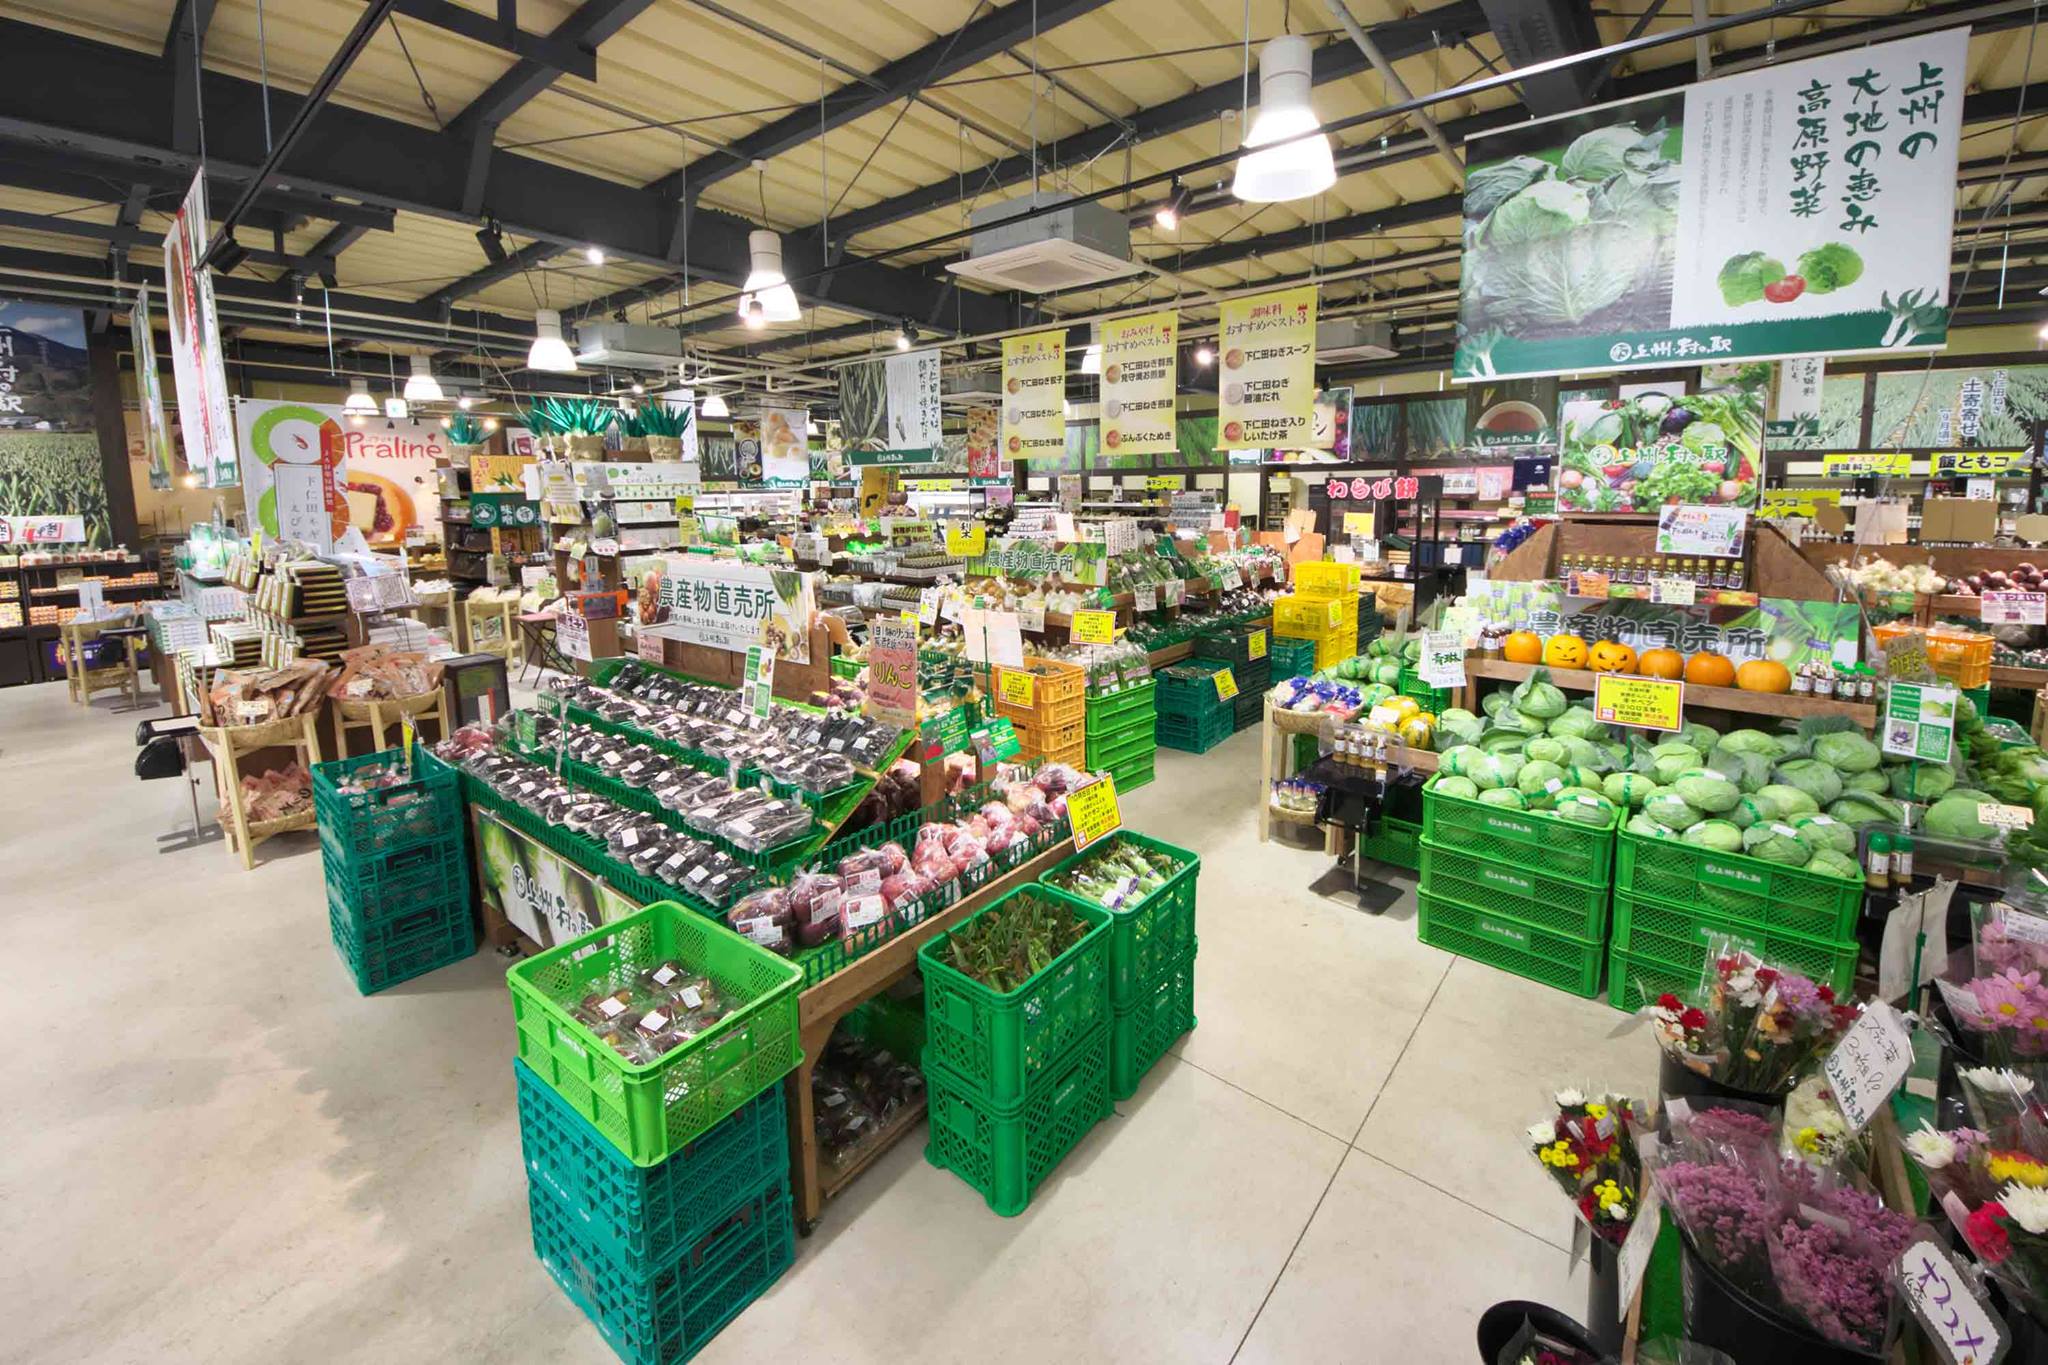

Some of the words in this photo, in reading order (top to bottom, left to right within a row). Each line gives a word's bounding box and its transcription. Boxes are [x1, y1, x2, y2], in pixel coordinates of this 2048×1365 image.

[1899, 62, 1944, 159] 上州の
[1790, 79, 1832, 219] 高原野菜
[1839, 69, 1892, 234] 大地の恵み
[1245, 344, 1311, 361] 下仁田ねぎスープ
[1631, 335, 1732, 359] 上州村の駅
[1245, 379, 1289, 392] 下仁田ねぎ
[1020, 408, 1063, 419] 下仁田ねぎカレー
[1244, 417, 1306, 430] 下仁田ねぎ入り
[1121, 432, 1172, 443] ぶんぶくたぬき
[1244, 430, 1288, 442] しいたけ茶
[1326, 477, 1419, 500] わらび餅
[989, 549, 1073, 573] 農産物直売所
[658, 576, 776, 621] 農産物直売所
[1528, 610, 1769, 664] 農産物直売所
[874, 661, 913, 690] りんご
